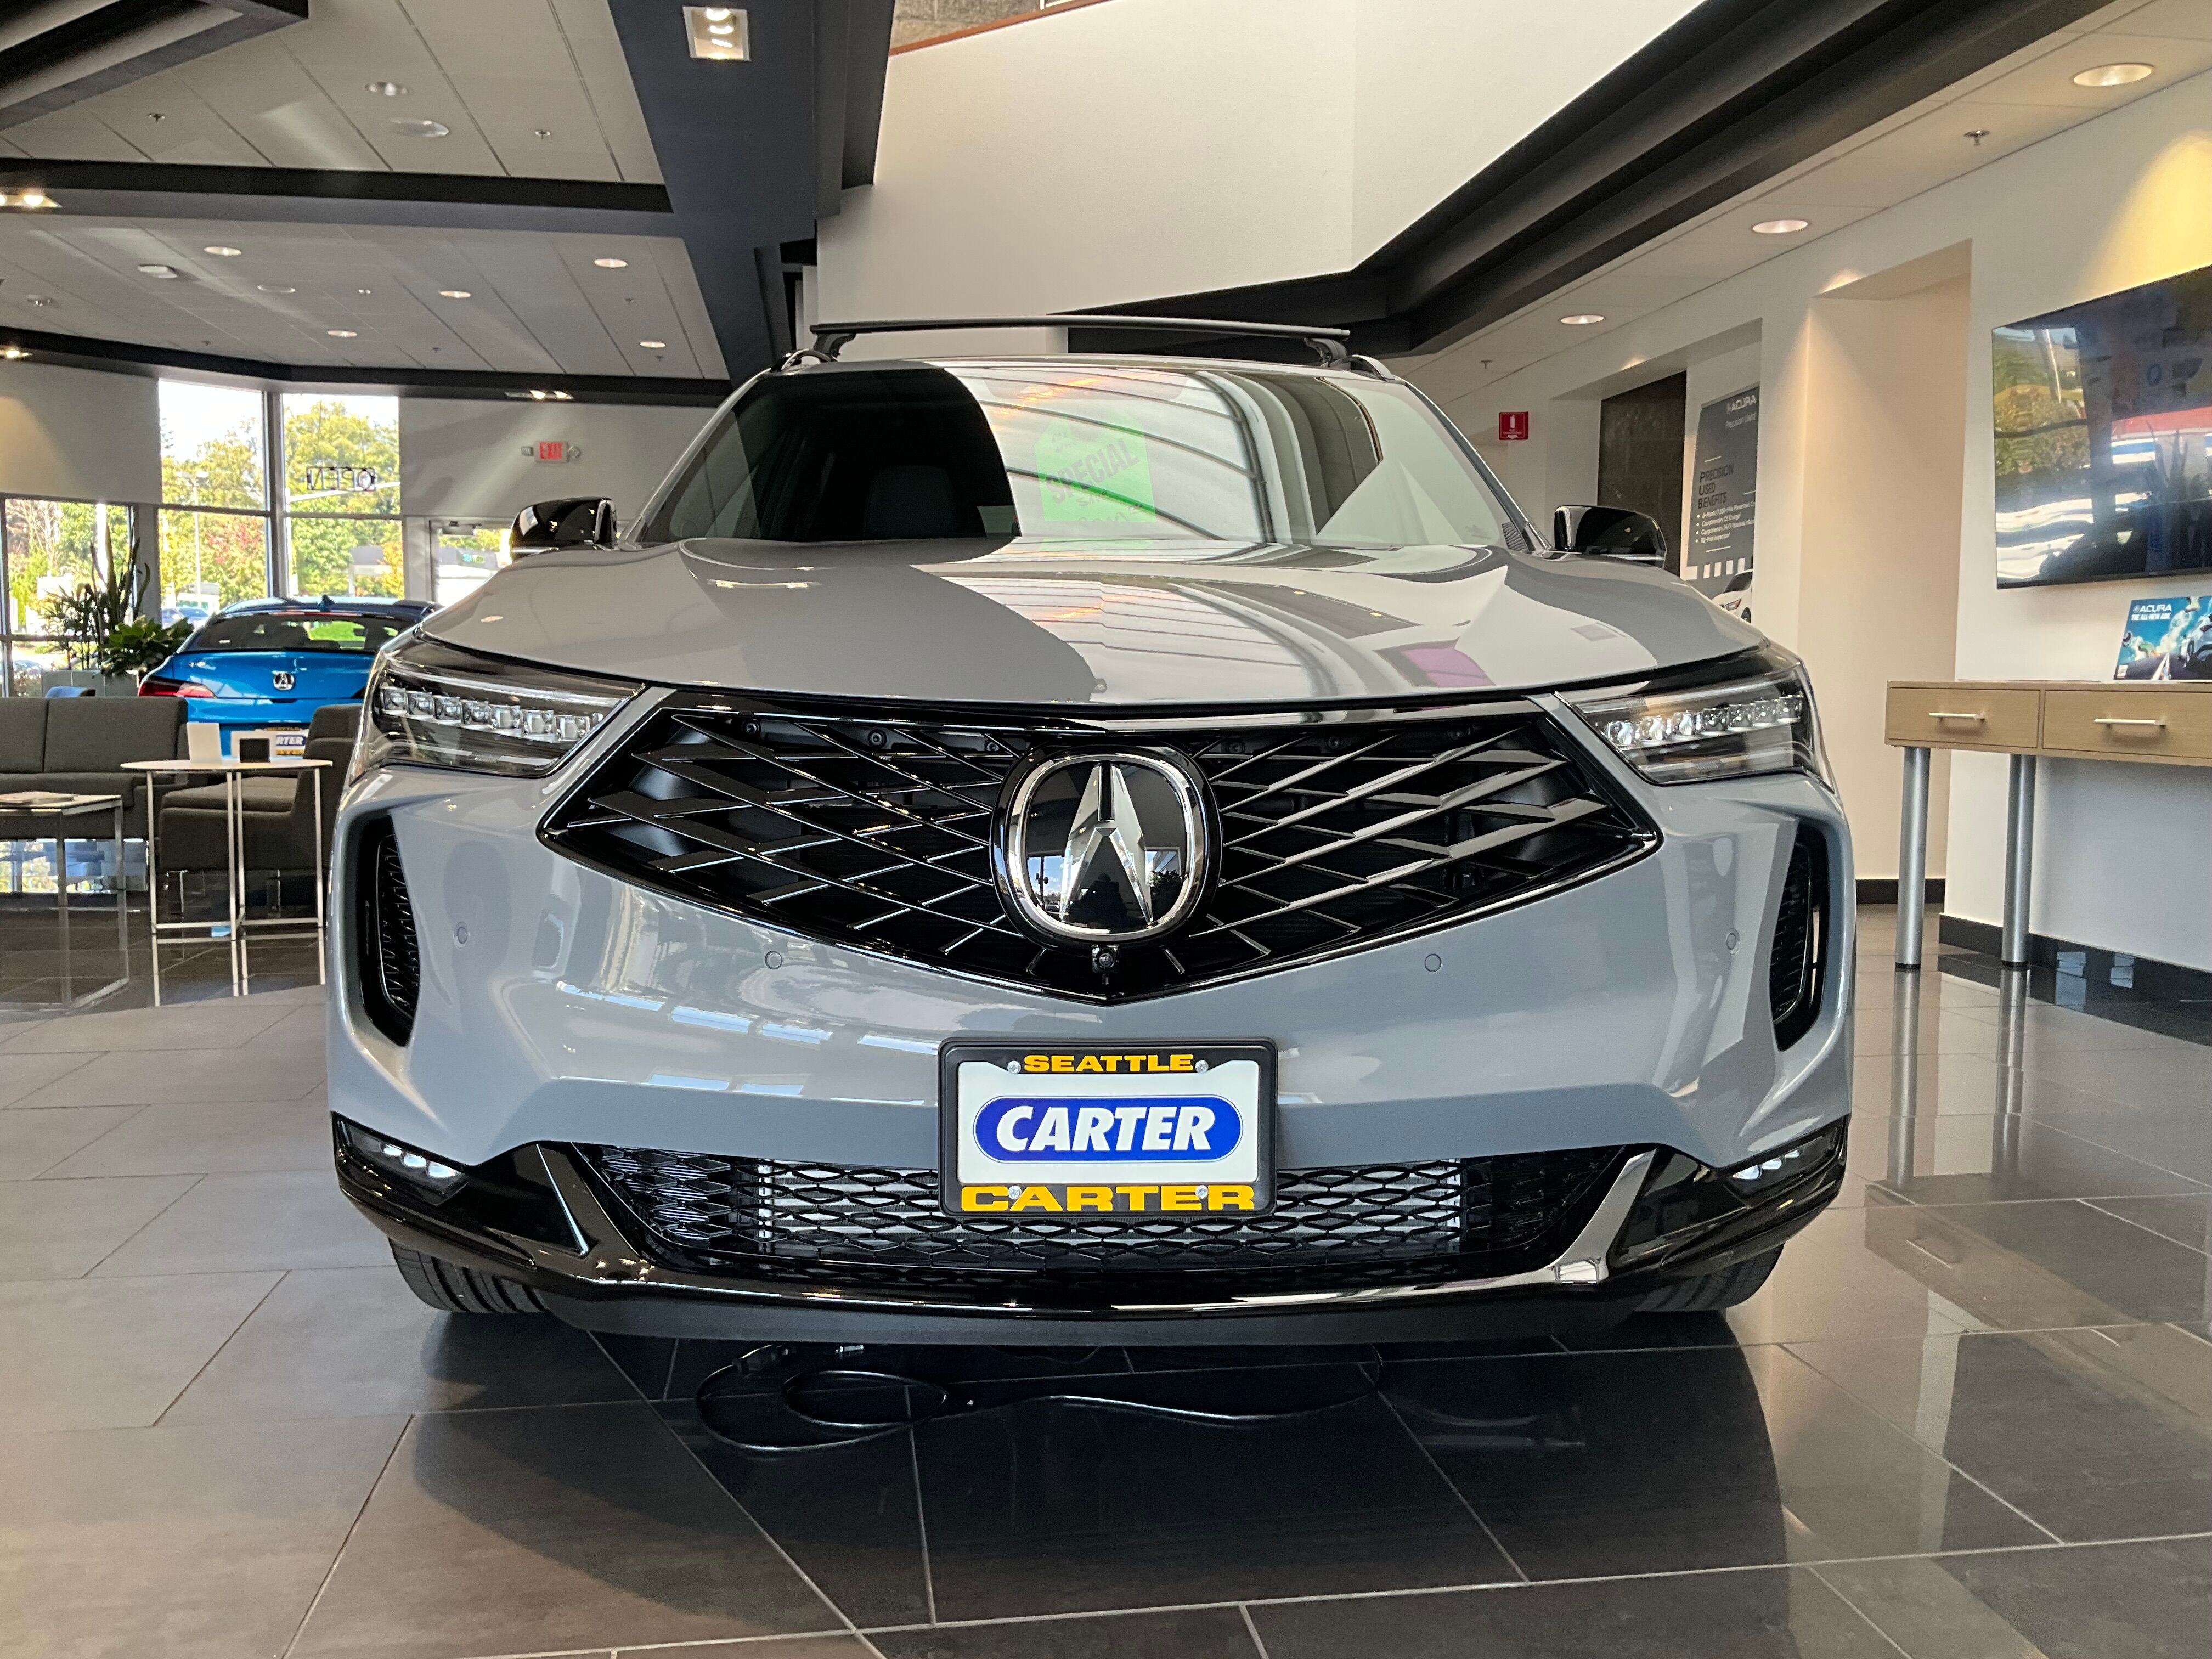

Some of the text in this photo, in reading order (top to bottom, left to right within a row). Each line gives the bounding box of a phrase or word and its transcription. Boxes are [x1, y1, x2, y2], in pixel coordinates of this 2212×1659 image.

[1731, 395, 1757, 411] ACURA
[540, 442, 562, 459] EXIT
[1045, 438, 1140, 504] SPECIAL
[1700, 464, 1734, 482] PRECISION
[1699, 482, 1716, 495] USED
[1698, 492, 1727, 509] BENEFITS
[2139, 604, 2172, 613] ACURA
[276, 736, 303, 745] RTER
[1024, 1054, 1193, 1072] SEATTLE
[996, 1106, 1215, 1152] CARTER
[961, 1186, 1254, 1211] CARTER
